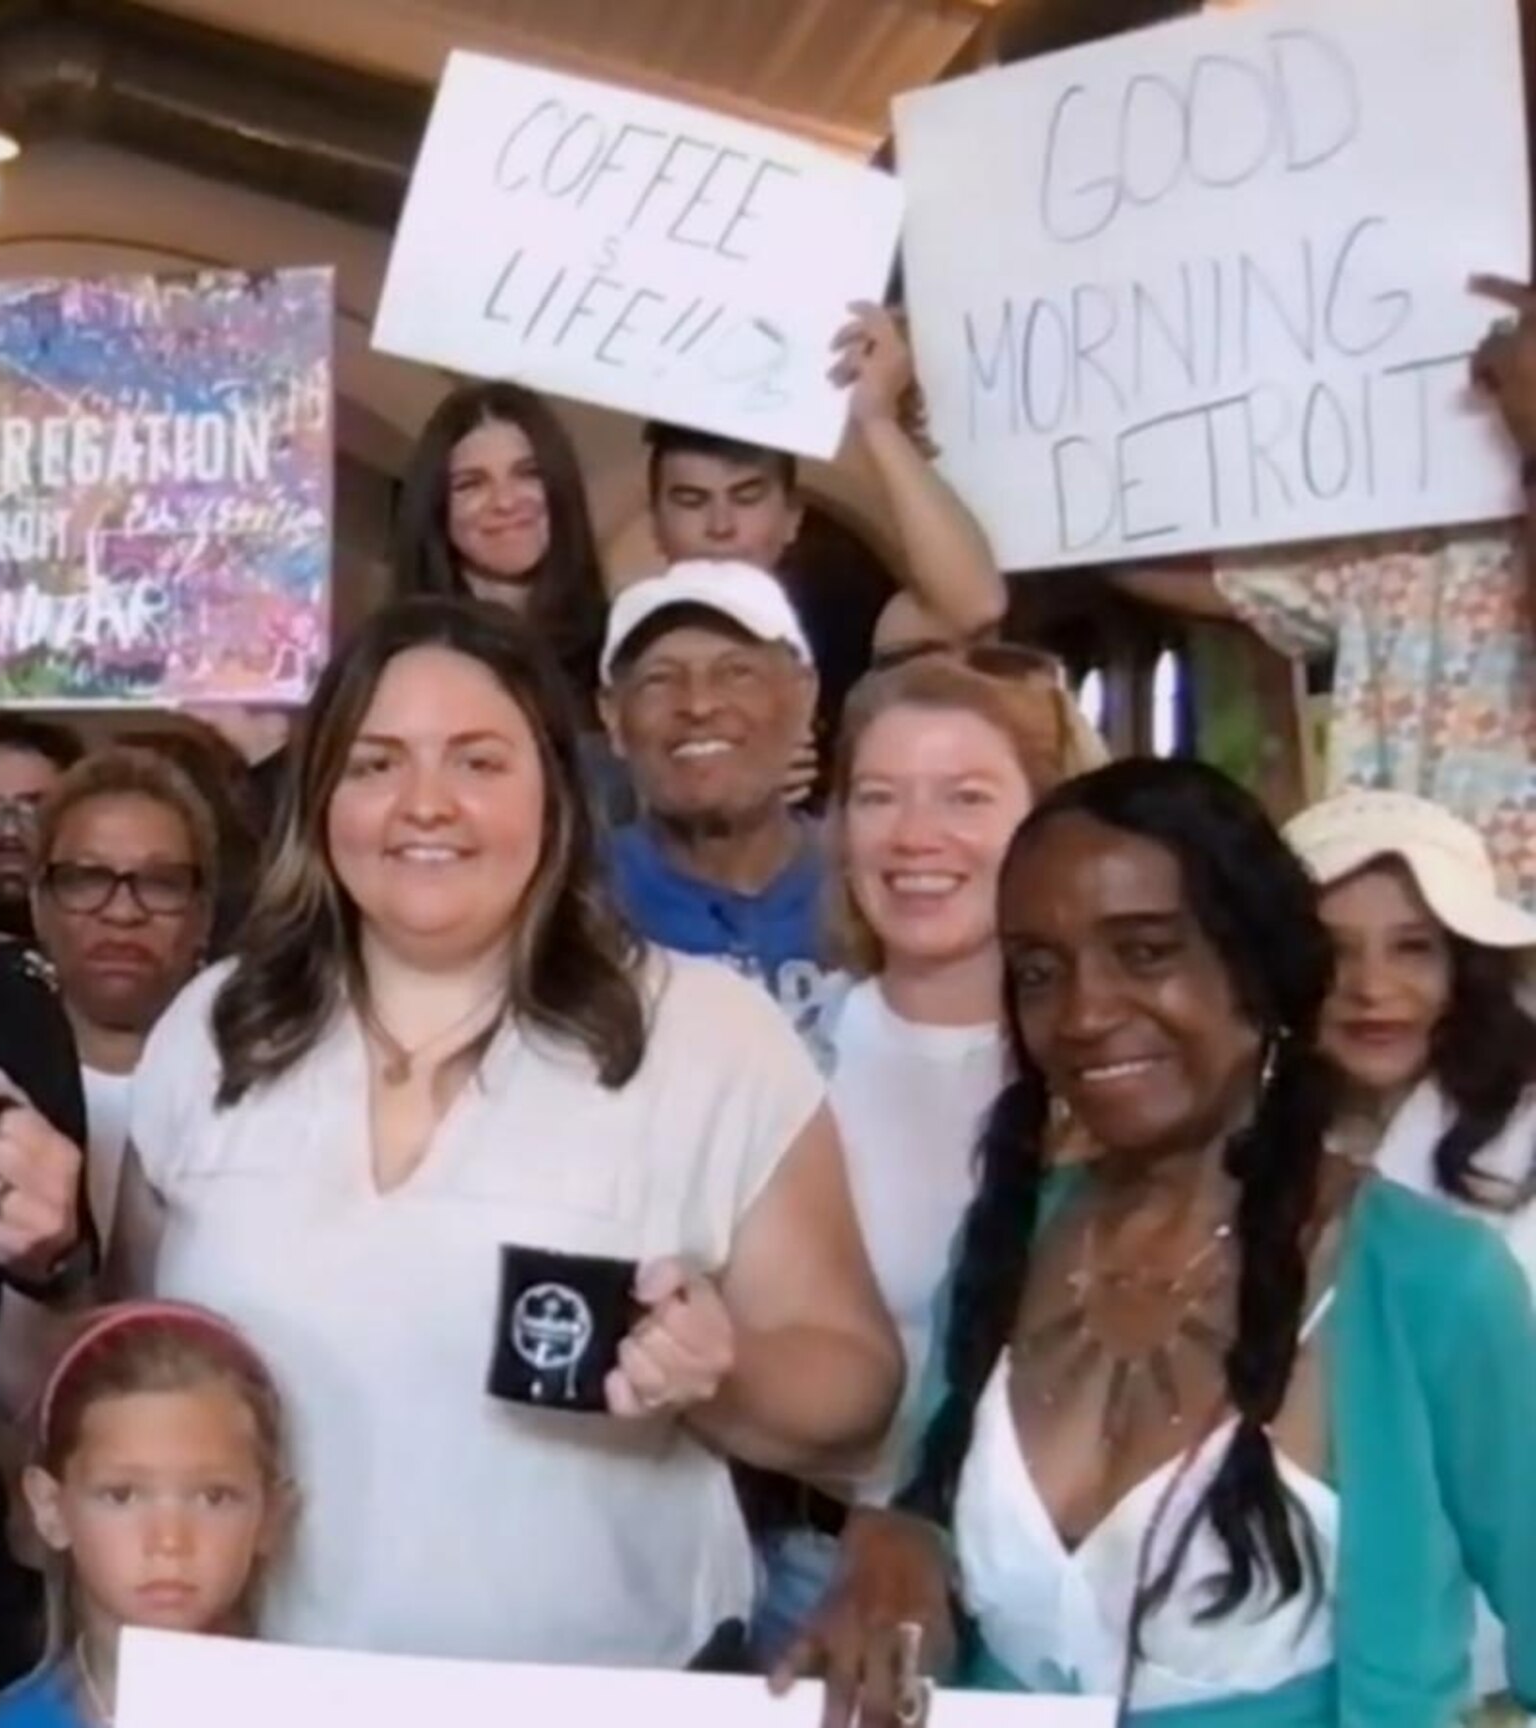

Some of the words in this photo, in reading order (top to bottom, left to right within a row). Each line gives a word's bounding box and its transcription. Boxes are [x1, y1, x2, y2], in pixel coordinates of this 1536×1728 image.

[493, 97, 802, 262] COFFEE
[1040, 28, 1362, 244] GOOD
[482, 247, 728, 368] LIFE!!
[964, 216, 1414, 442] MORNING
[1050, 350, 1477, 554] DETROIT
